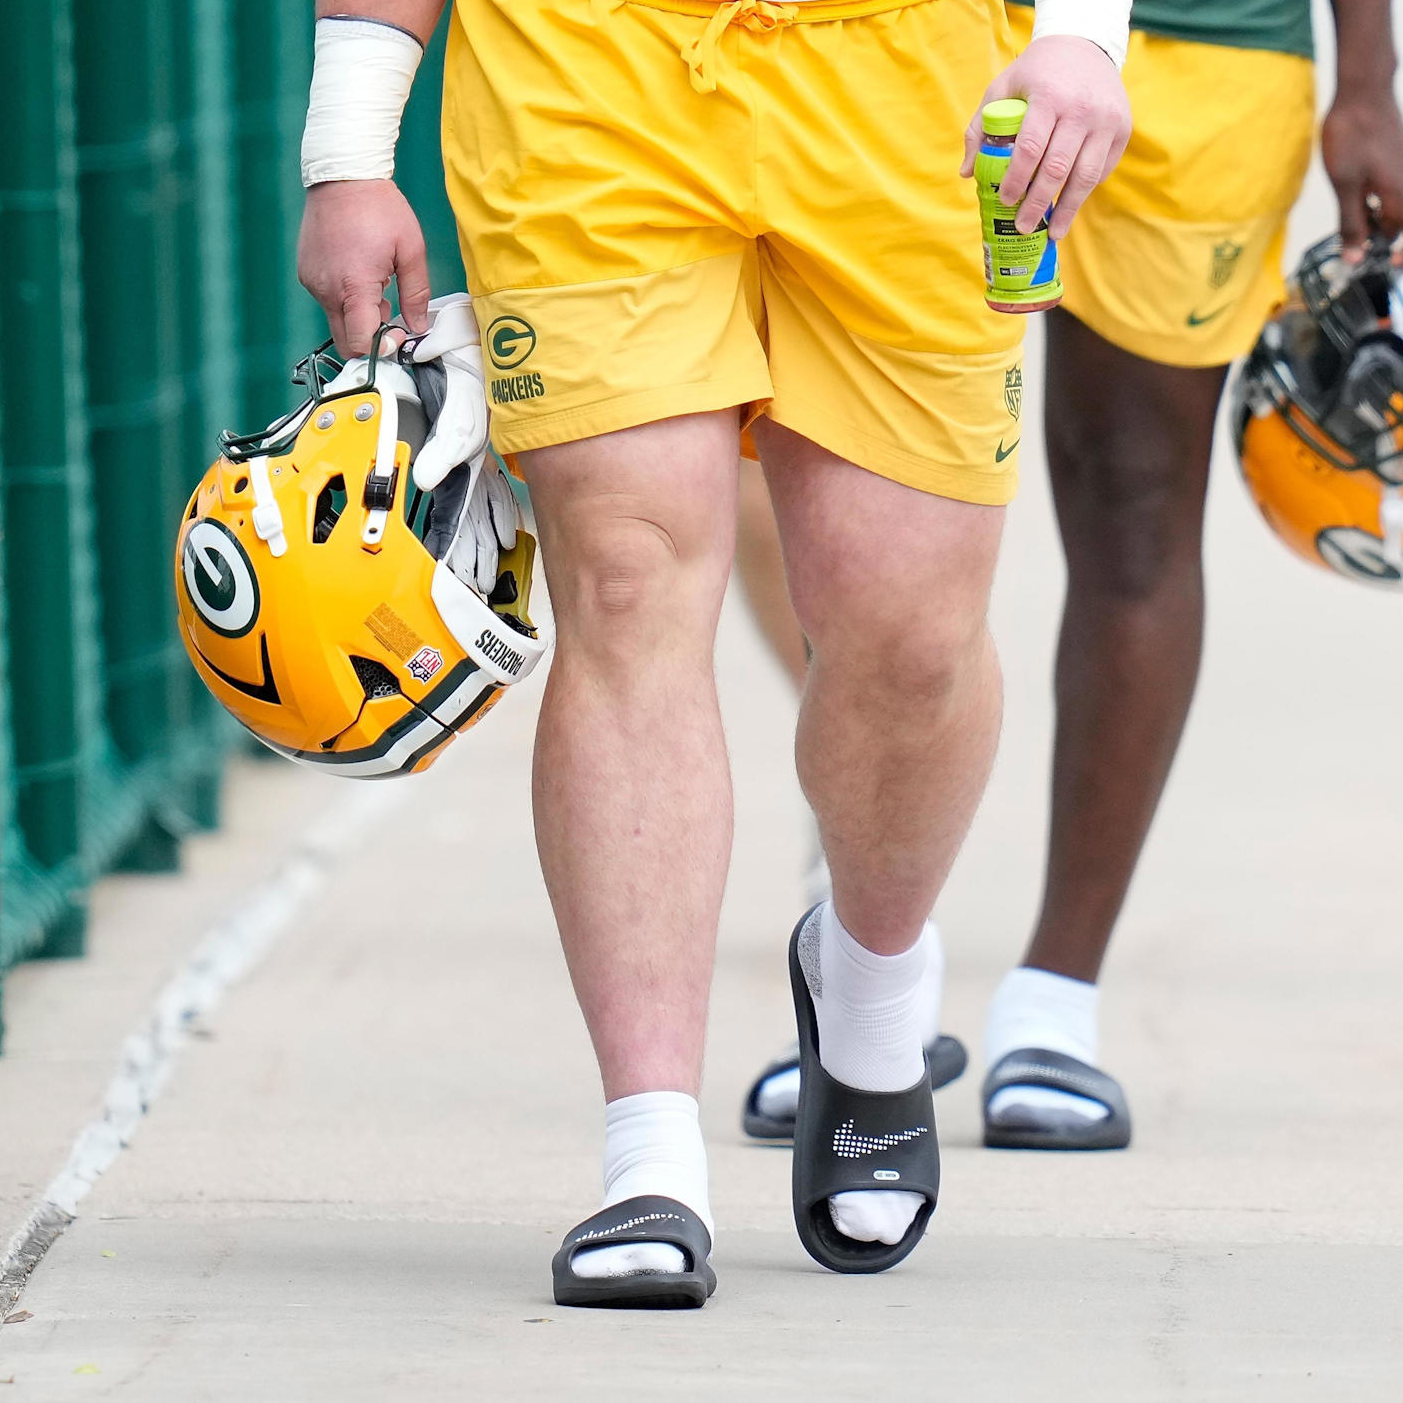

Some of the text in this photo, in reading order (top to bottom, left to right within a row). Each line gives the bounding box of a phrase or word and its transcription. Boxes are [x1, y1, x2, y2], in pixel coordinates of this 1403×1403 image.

[491, 372, 545, 404] PACKERS
[419, 650, 441, 674] NFL
[475, 629, 526, 676] PACKERS
